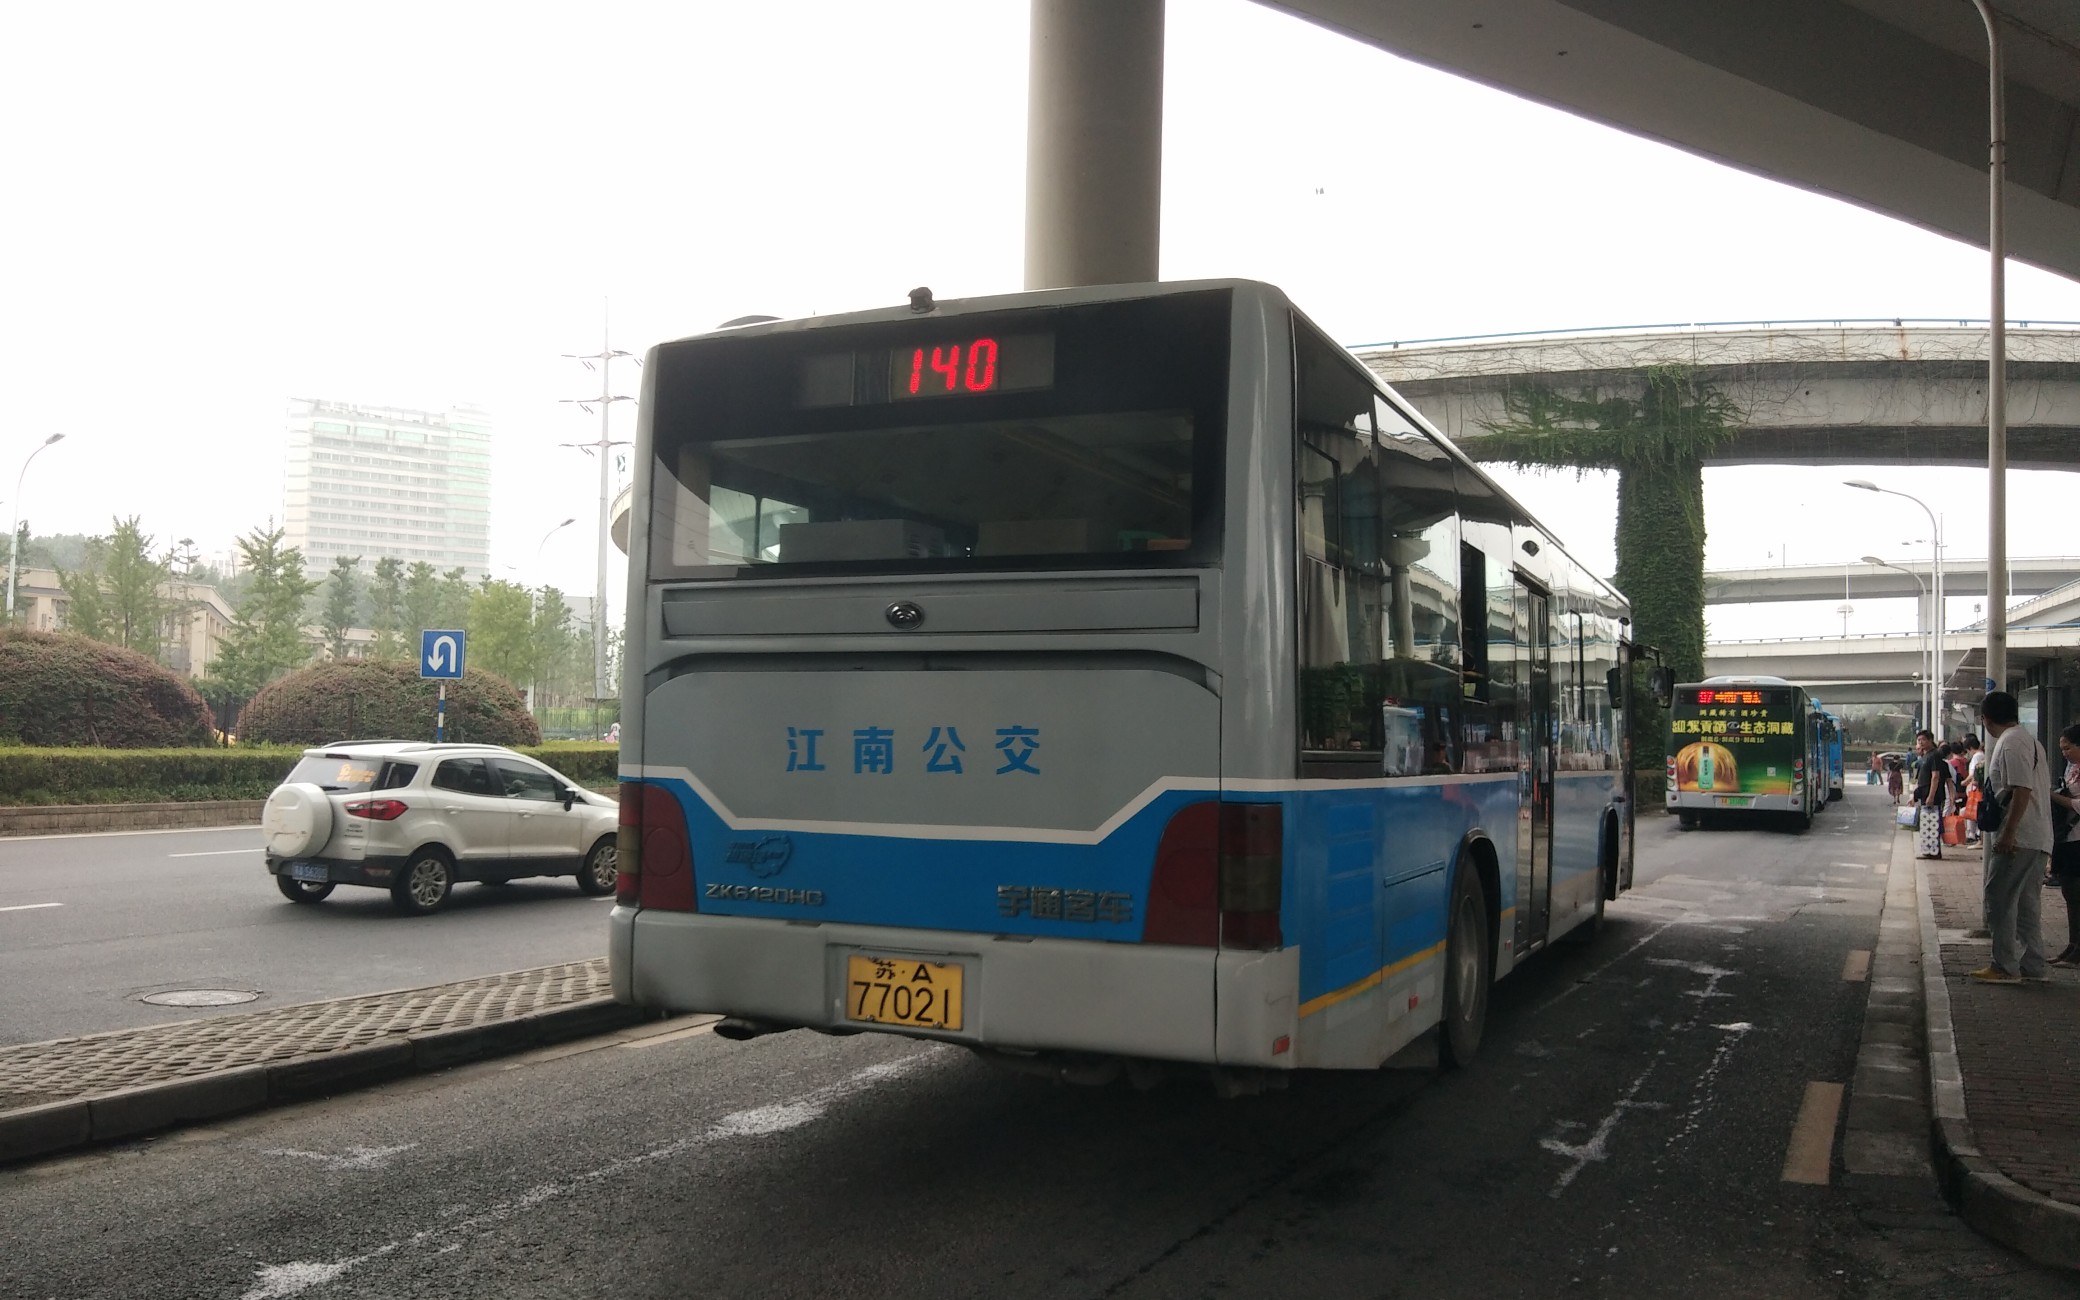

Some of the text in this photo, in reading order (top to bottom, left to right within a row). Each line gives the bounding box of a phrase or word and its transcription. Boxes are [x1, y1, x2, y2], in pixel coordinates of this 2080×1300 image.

[909, 338, 998, 395] 140
[1739, 721, 1794, 735] 生态洞藏
[786, 725, 1041, 775] 江南公交
[997, 885, 1132, 924] 宇通客车
[853, 981, 949, 1024] 77021
